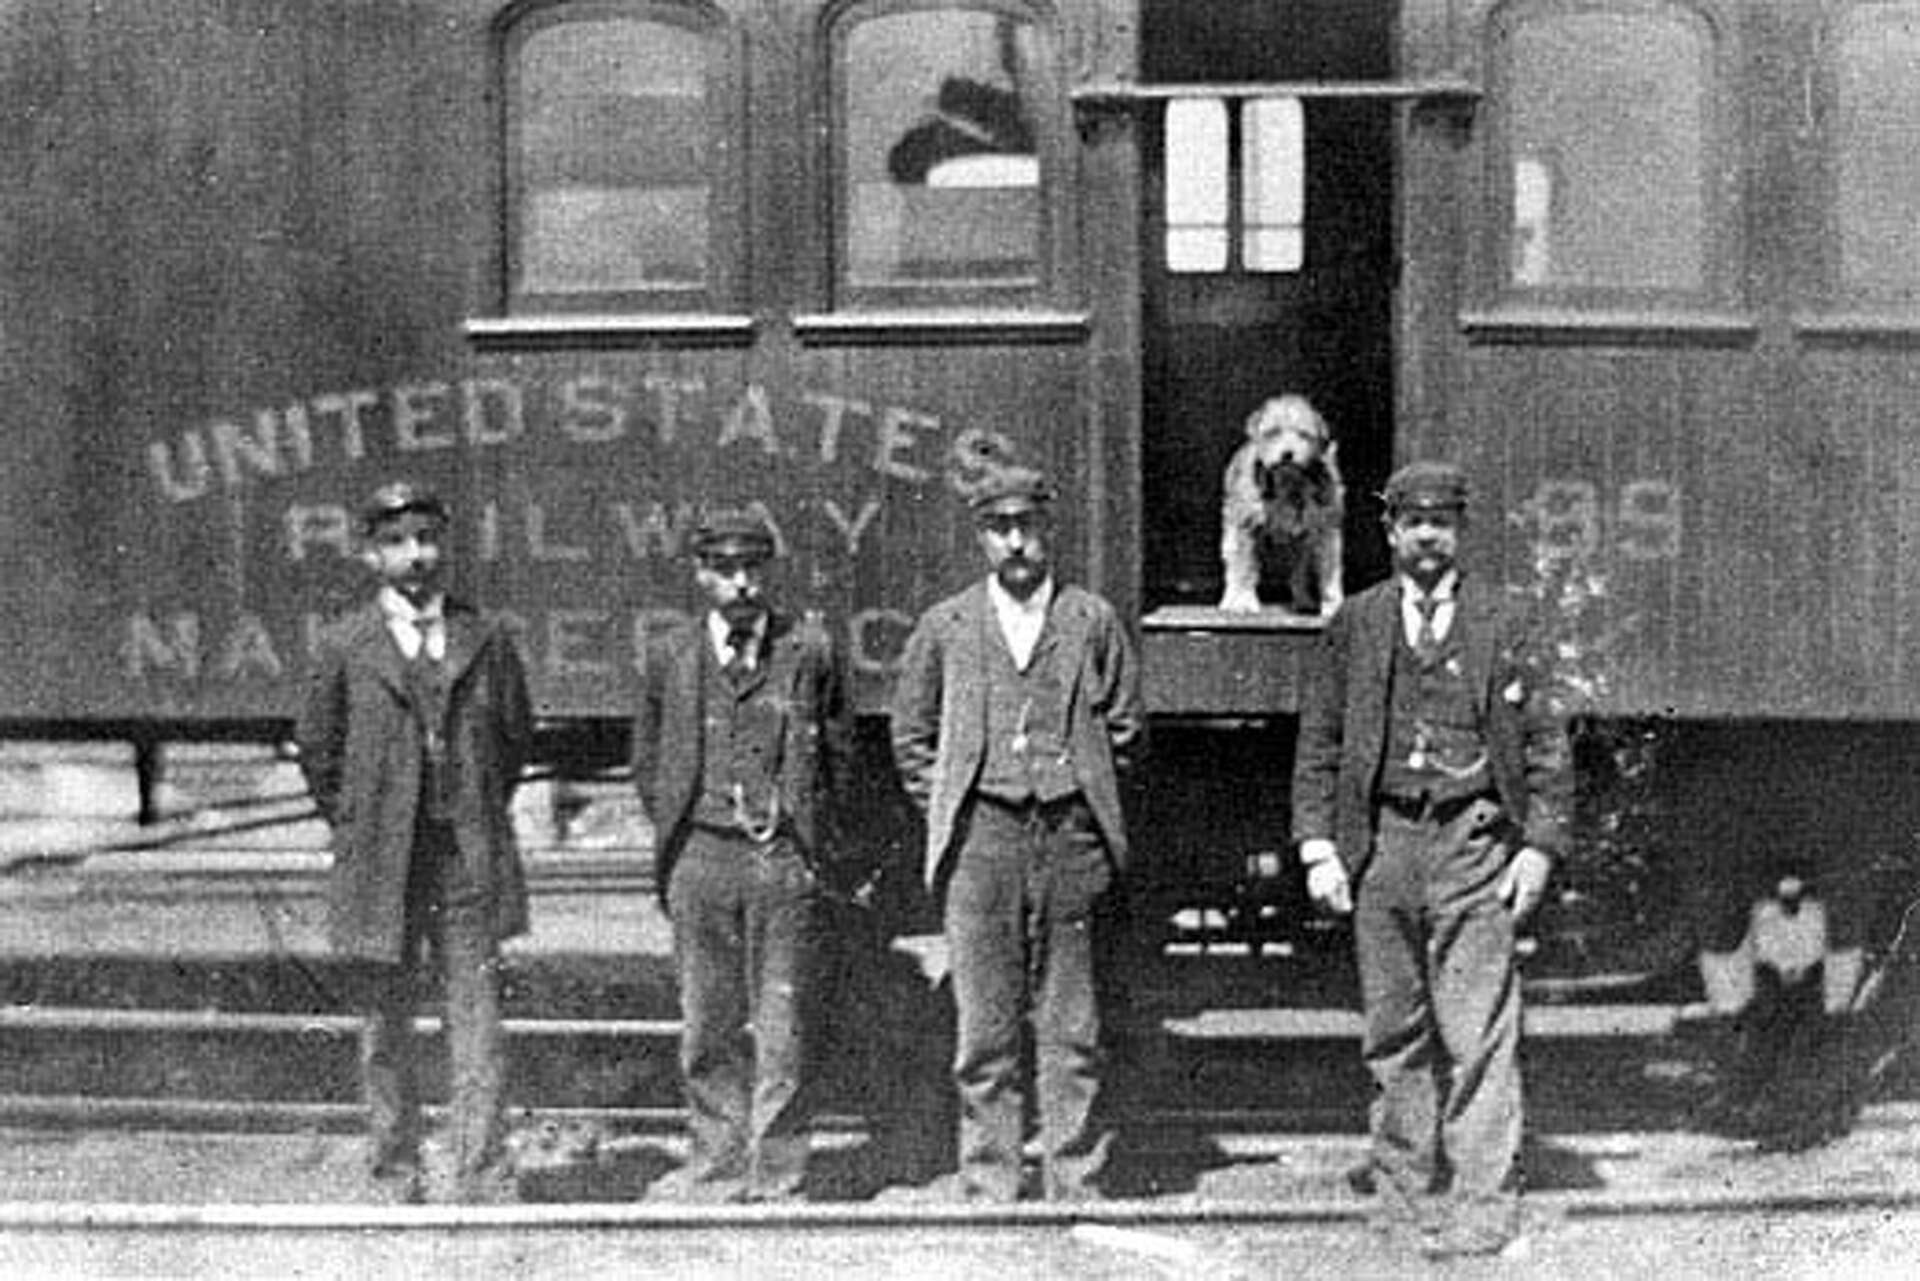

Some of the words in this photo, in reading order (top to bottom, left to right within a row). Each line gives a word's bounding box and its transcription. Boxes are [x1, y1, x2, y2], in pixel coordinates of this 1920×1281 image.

[150, 376, 524, 500] UNITED
[561, 374, 1016, 493] STATES
[286, 498, 882, 561] RILWAY
